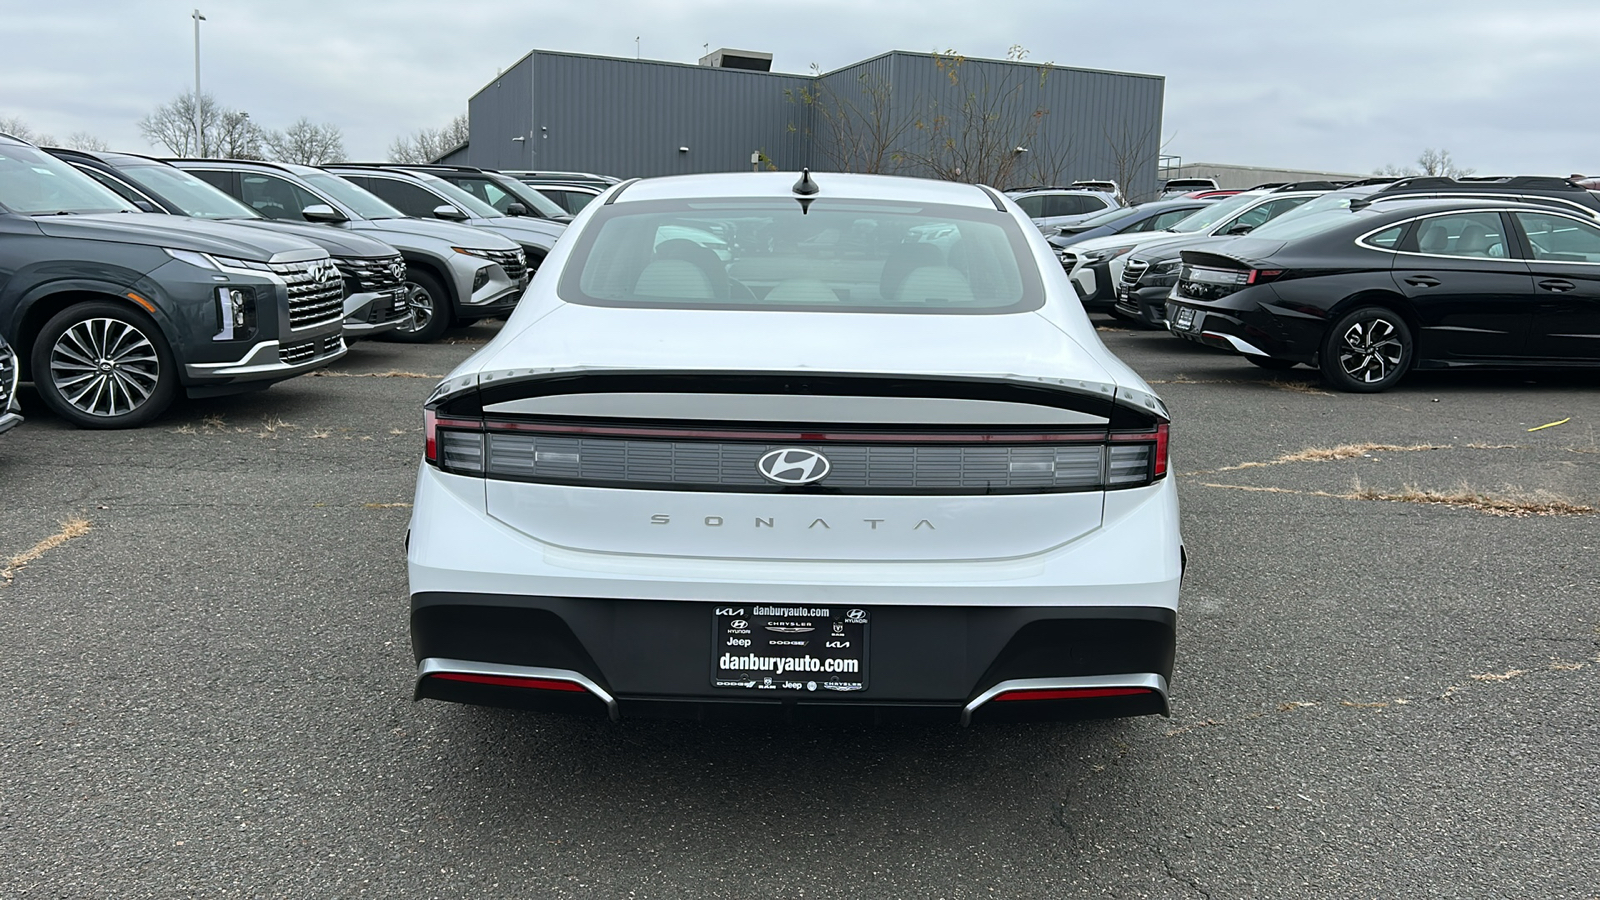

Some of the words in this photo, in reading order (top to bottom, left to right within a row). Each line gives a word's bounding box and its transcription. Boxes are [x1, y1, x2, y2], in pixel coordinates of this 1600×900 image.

[650, 514, 936, 530] SONATA
[753, 606, 829, 617] danburyauto.com
[726, 637, 751, 647] Jeep
[719, 653, 859, 674] danburyauto.com
[782, 681, 803, 690] Jeep
